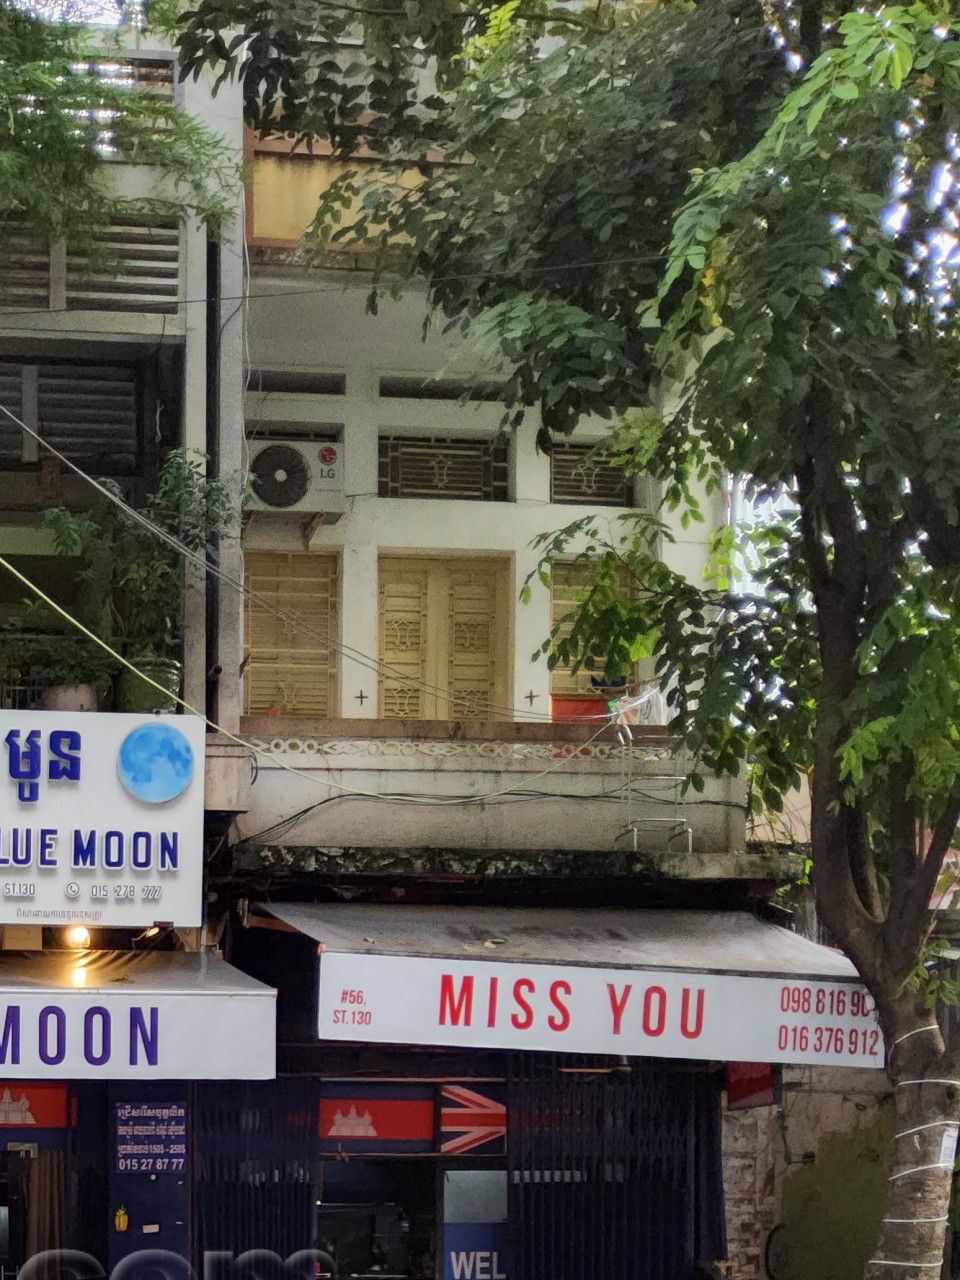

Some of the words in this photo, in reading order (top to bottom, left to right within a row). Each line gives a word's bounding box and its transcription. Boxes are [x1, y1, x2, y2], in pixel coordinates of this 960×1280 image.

[320, 468, 336, 478] LG
[73, 829, 179, 870] MOON
[91, 885, 109, 898] 015
[116, 885, 135, 898] 278
[438, 974, 572, 1032] MISS
[606, 983, 705, 1040] YOU
[781, 986, 811, 1014] 098
[815, 988, 846, 1016] 816
[332, 1009, 372, 1025] ST.130
[778, 1024, 809, 1052] 016
[813, 1026, 844, 1054] 376
[848, 1028, 879, 1056] 912
[119, 1159, 138, 1170] 015
[141, 1159, 153, 1170] 27
[156, 1159, 169, 1170] 87
[172, 1159, 184, 1170] 77
[450, 1251, 507, 1280] WEL
